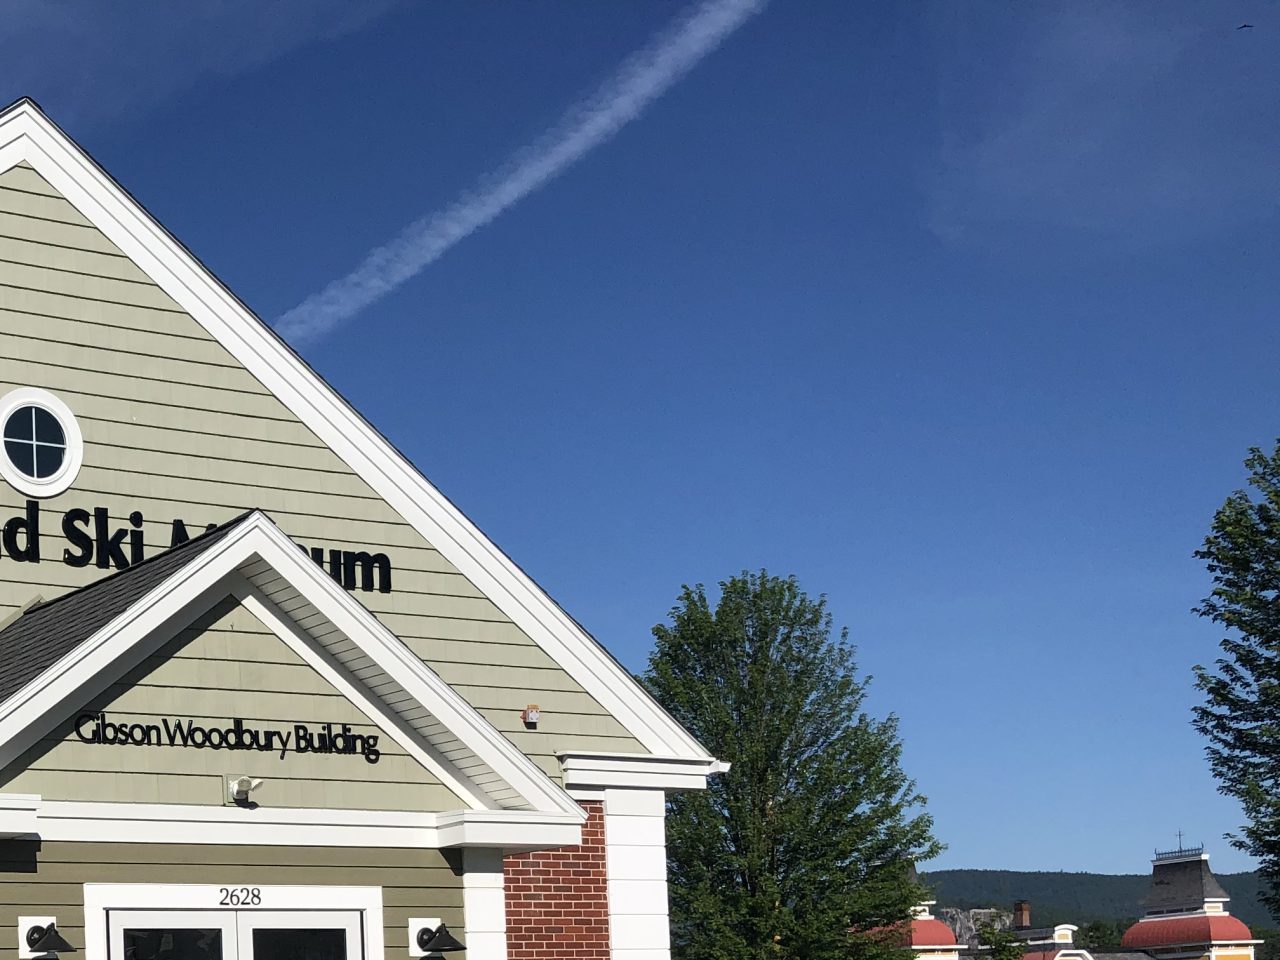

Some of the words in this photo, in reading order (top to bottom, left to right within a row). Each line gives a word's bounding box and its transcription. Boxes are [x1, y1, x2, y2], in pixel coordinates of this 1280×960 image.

[62, 507, 144, 571] Ski
[74, 712, 162, 746] Gibson
[161, 718, 291, 760] Woodbury
[294, 722, 380, 764] Building
[219, 887, 262, 906] 2628
